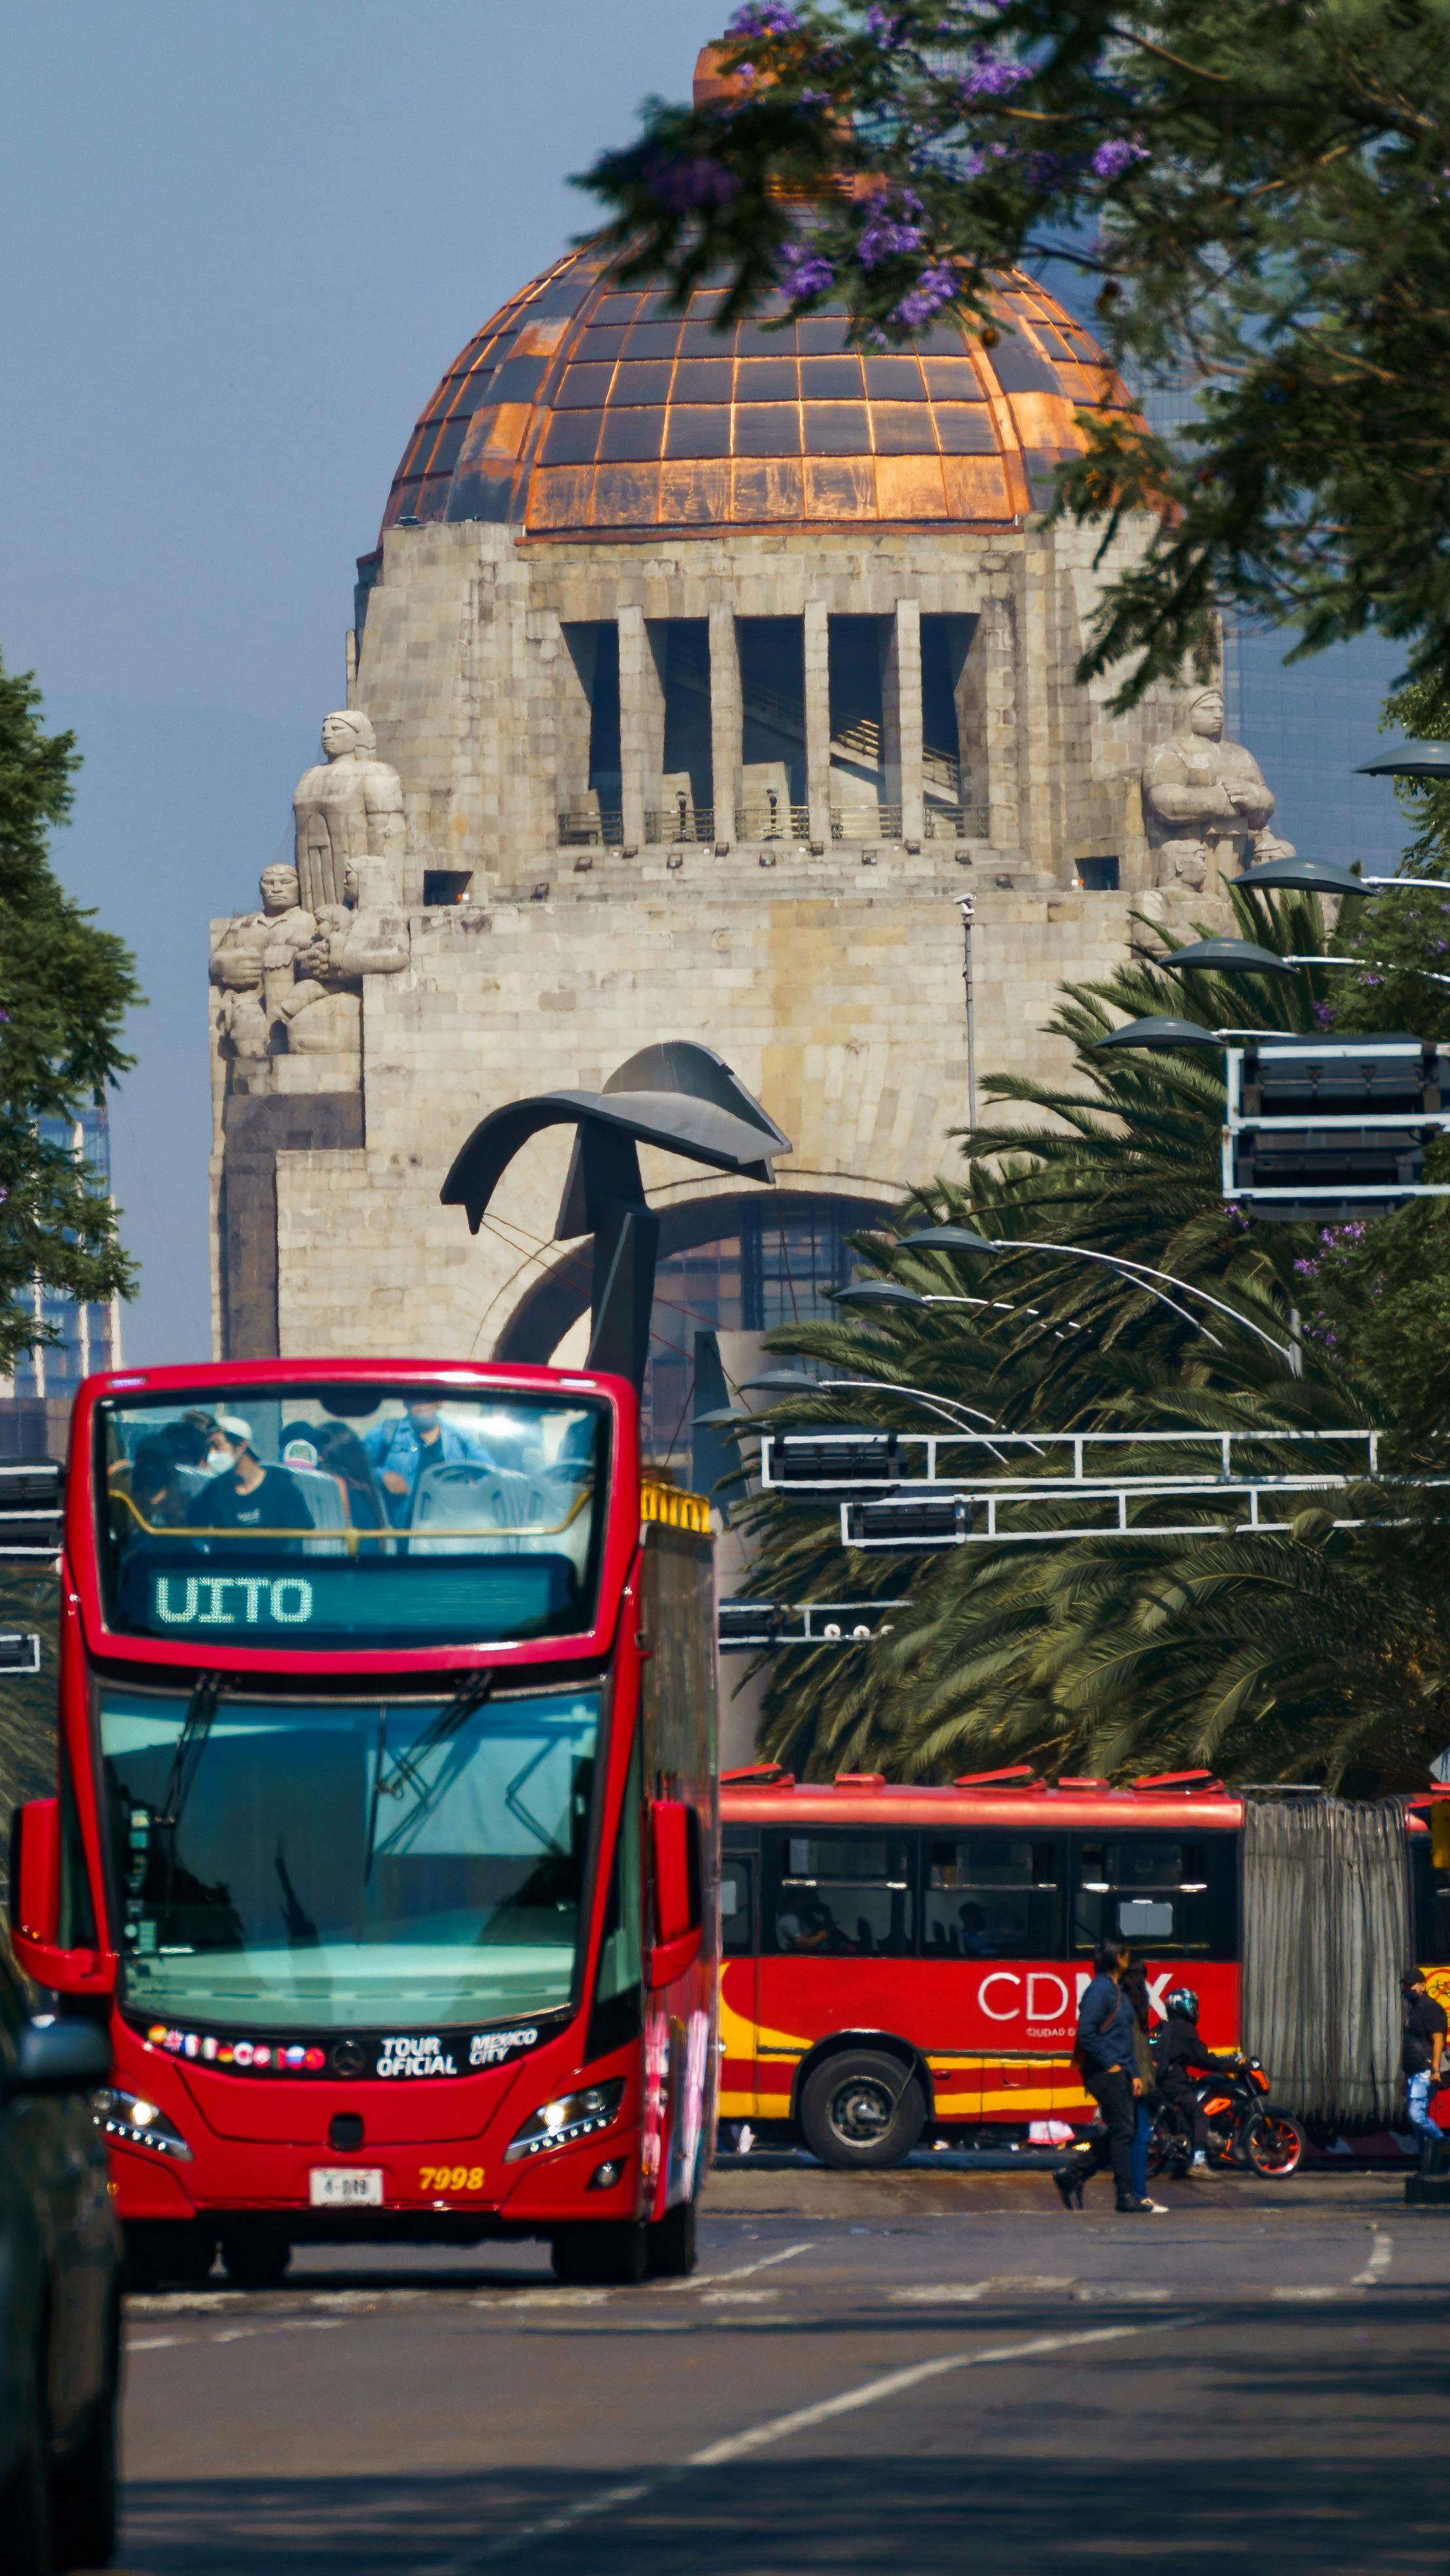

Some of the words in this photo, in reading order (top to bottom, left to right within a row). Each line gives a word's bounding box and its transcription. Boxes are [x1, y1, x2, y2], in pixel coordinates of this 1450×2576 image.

[156, 1577, 312, 1623] UITO
[470, 2028, 538, 2051] MEXICO
[1026, 2027, 1065, 2037] CIUDAD
[1067, 2027, 1076, 2037] D
[381, 2037, 442, 2058] TOUR
[469, 2045, 510, 2066] CITY
[376, 2054, 457, 2077] OFICIAL
[419, 2166, 485, 2191] 7998
